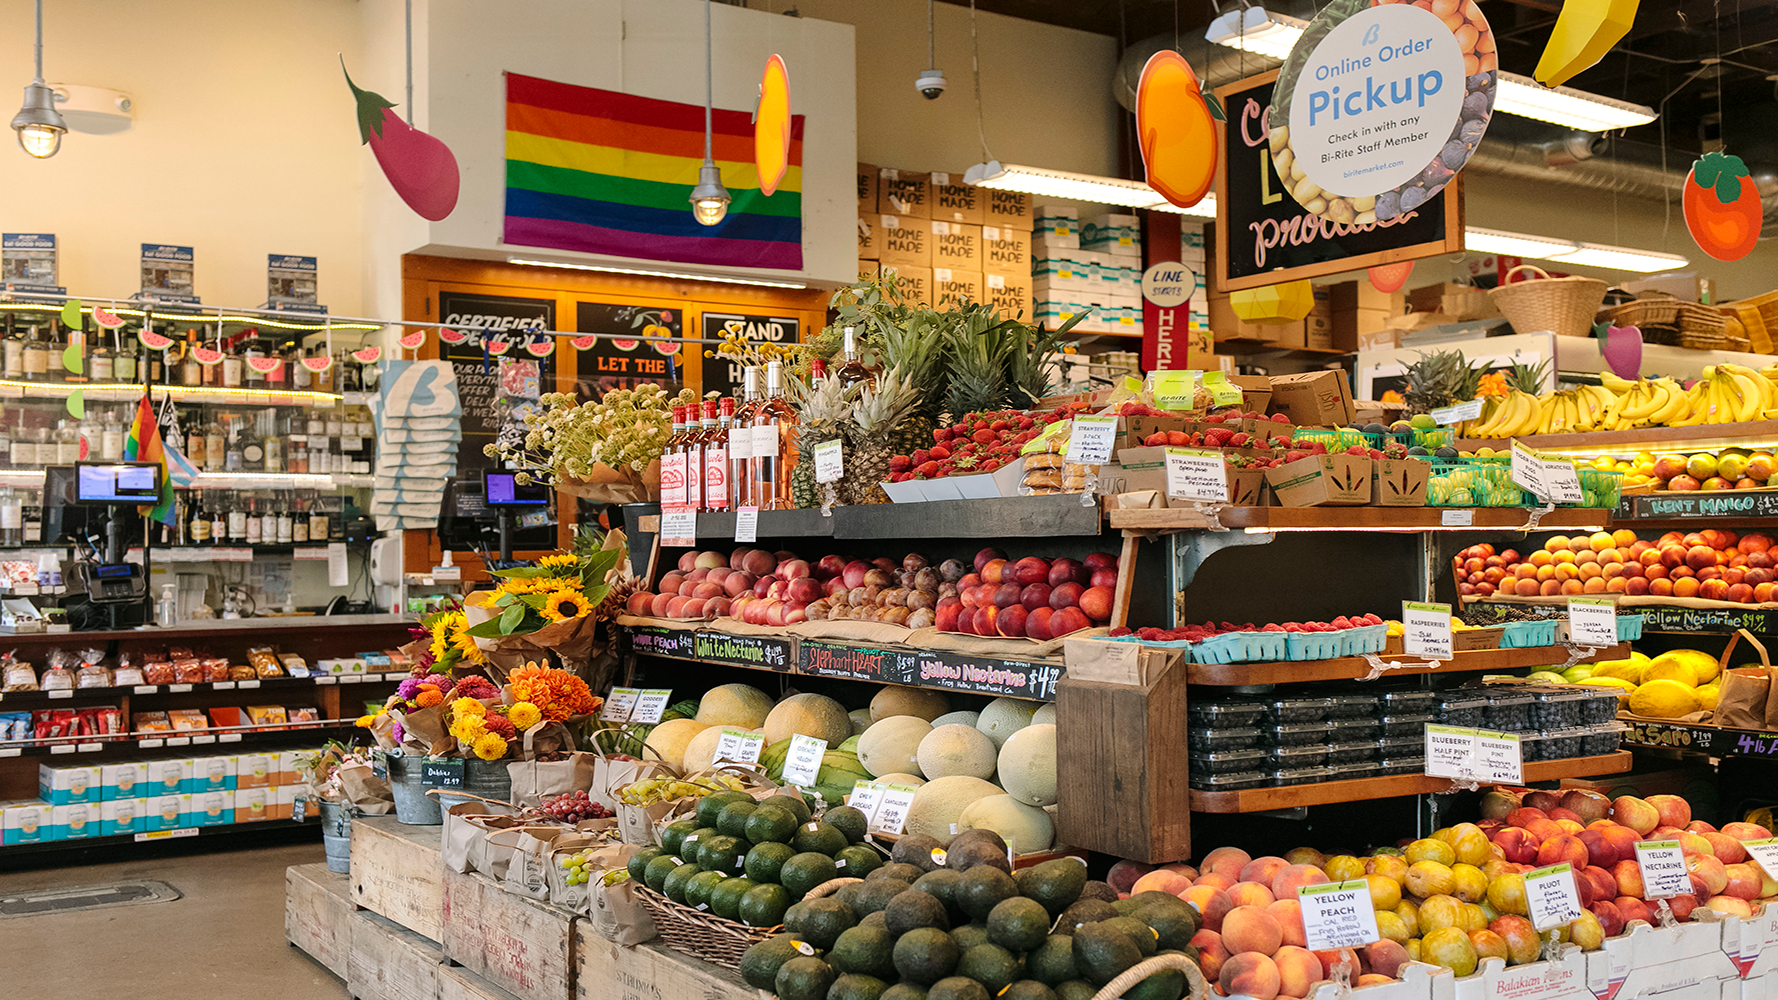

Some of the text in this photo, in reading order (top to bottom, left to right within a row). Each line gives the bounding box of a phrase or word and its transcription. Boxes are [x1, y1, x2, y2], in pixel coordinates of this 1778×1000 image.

[1316, 38, 1433, 80] Online Order
[1309, 70, 1443, 126] Pickup
[1328, 116, 1420, 144] Check in with any
[1321, 132, 1429, 163] Bi-Rite Staff Member
[1343, 160, 1404, 178] biritemarket.com
[889, 179, 925, 193] HOME
[940, 185, 976, 198] HOME
[888, 190, 925, 205] MADE
[940, 197, 976, 211] MADE
[992, 191, 1025, 204] HOME
[992, 203, 1026, 217] MADE
[888, 228, 924, 241] HOME
[940, 234, 974, 247] HOME
[888, 240, 924, 254] MADE
[990, 239, 1024, 252] HOME
[940, 246, 974, 259] MADE
[990, 251, 1024, 264] MADE
[1153, 271, 1184, 283] LINE
[941, 281, 975, 293] HOME
[993, 285, 1024, 298] HOME
[1152, 287, 1182, 297] STARTS
[898, 288, 924, 301] ADE
[992, 297, 1025, 309] MADE
[724, 321, 784, 342] STAND
[1157, 310, 1174, 371] HERE
[453, 364, 474, 374] OUR
[597, 356, 666, 374] LET THE
[456, 375, 499, 386] EVERYTH
[459, 385, 491, 396] OFFER
[1171, 459, 1219, 468] STRAWBERRIES
[1651, 496, 1755, 514] KENT MANGO
[1643, 611, 1681, 625] Yellow
[1684, 612, 1741, 627] Nectarine
[653, 636, 678, 649] PEACH
[697, 637, 724, 657] White
[725, 640, 763, 662] Nectarine
[852, 652, 885, 674] HEART
[920, 660, 1026, 687] Yellow Nectarine
[1431, 736, 1471, 746] BLUEBERRY
[1481, 742, 1513, 750] BLUEBERRY
[1434, 747, 1469, 757] HALF PINT
[885, 799, 908, 807] CANTALOUPE
[1645, 862, 1682, 870] NECTARINE
[1539, 880, 1560, 890] PLUOT
[1314, 893, 1355, 904] YELLOW
[1320, 906, 1355, 917] PEACH
[1496, 977, 1540, 994] Balakian
